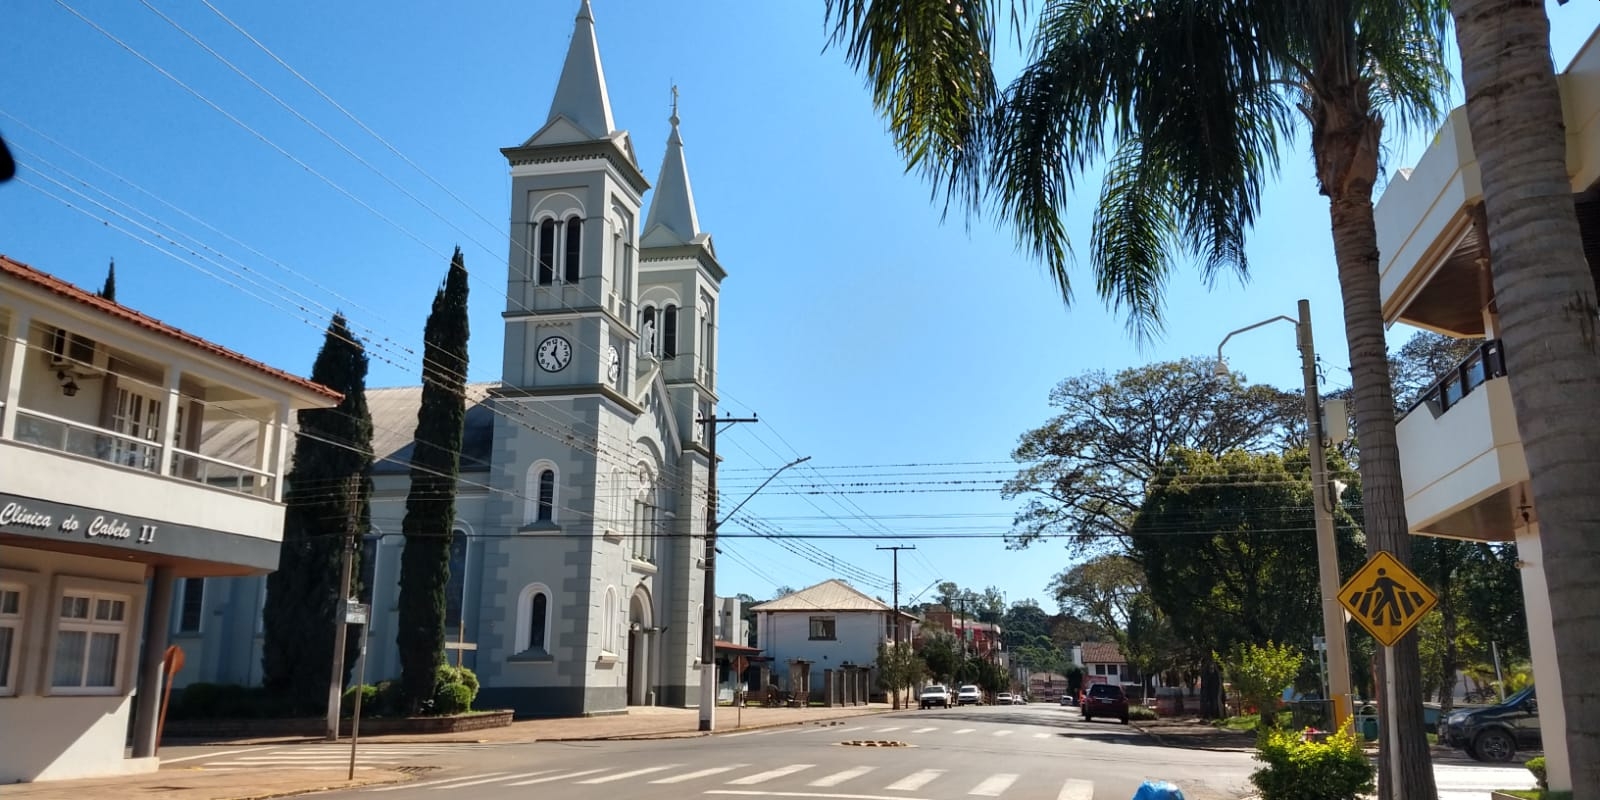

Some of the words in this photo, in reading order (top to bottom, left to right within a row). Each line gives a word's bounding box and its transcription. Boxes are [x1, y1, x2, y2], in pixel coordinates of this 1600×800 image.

[62, 515, 79, 531] do
[88, 515, 131, 538] Cabelo
[139, 525, 157, 542] II
